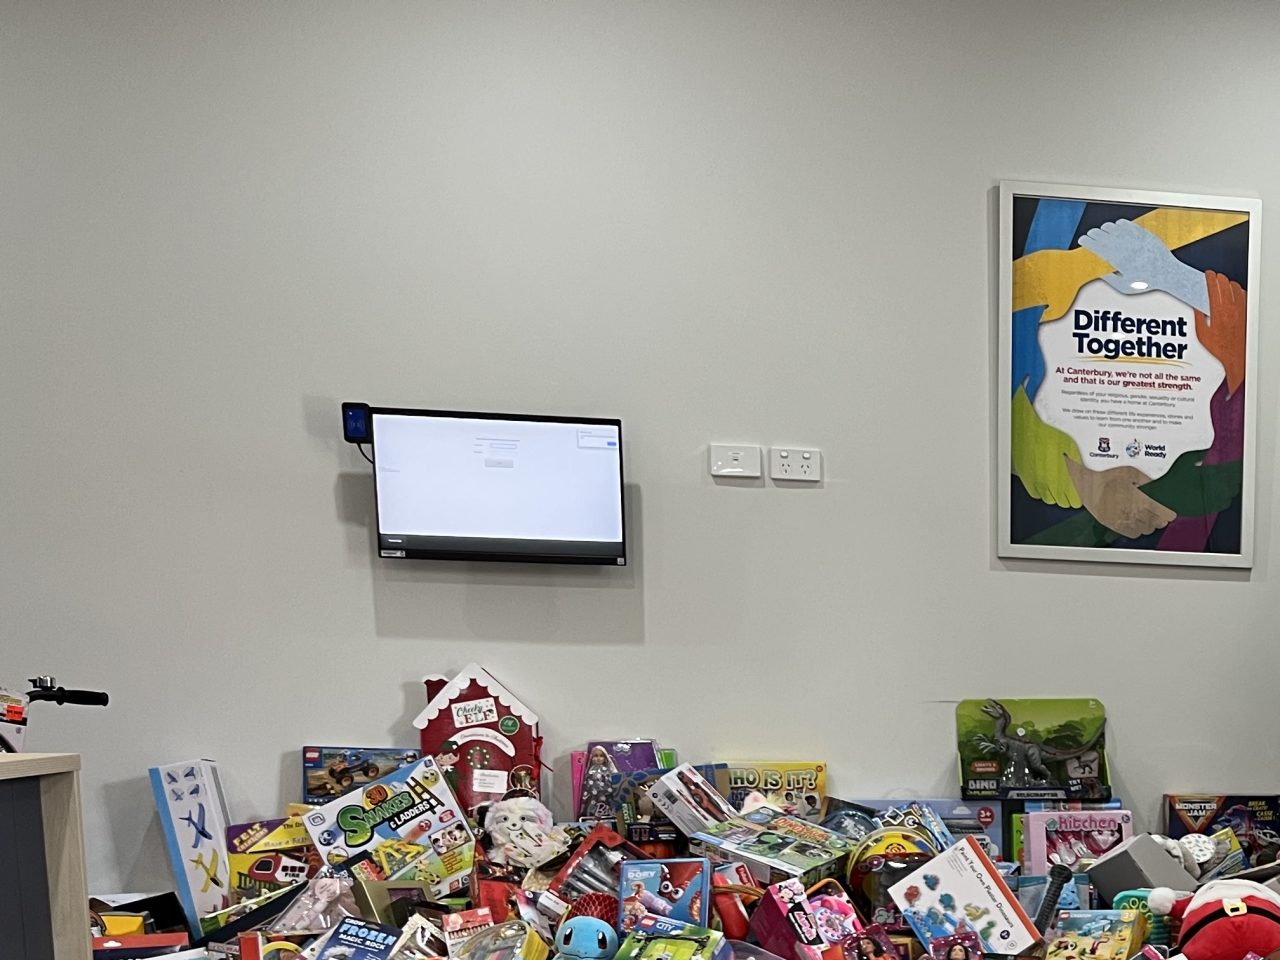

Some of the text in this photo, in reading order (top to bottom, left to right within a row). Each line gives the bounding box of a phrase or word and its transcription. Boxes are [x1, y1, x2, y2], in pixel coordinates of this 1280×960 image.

[1074, 309, 1188, 337] Different
[1072, 332, 1188, 360] Together
[1067, 367, 1113, 378] Canterbury,
[1115, 371, 1137, 379] we're
[1154, 372, 1164, 380] all
[1165, 373, 1179, 381] the
[1180, 374, 1202, 382] same
[1063, 376, 1079, 384] and
[1080, 377, 1098, 385] that
[1099, 377, 1105, 385] is
[1122, 380, 1156, 389] greatest
[1157, 381, 1193, 391] strength.
[1089, 451, 1119, 459] Canterbury
[1144, 450, 1166, 459] Ready
[456, 704, 483, 718] Cheeky
[463, 709, 494, 725] ELF
[729, 768, 818, 790] HO IS IT?
[968, 780, 998, 789] DINO
[365, 784, 389, 806] 3D
[394, 800, 431, 825] LADDERS
[979, 809, 992, 818] 3+
[1175, 802, 1217, 811] MONSTER
[338, 790, 414, 847] SNAKES
[232, 822, 262, 847] FELT
[338, 923, 398, 946] FROZEN
[656, 922, 675, 932] CITY
[338, 933, 364, 944] MAGIC
[364, 940, 387, 950] ROCK
